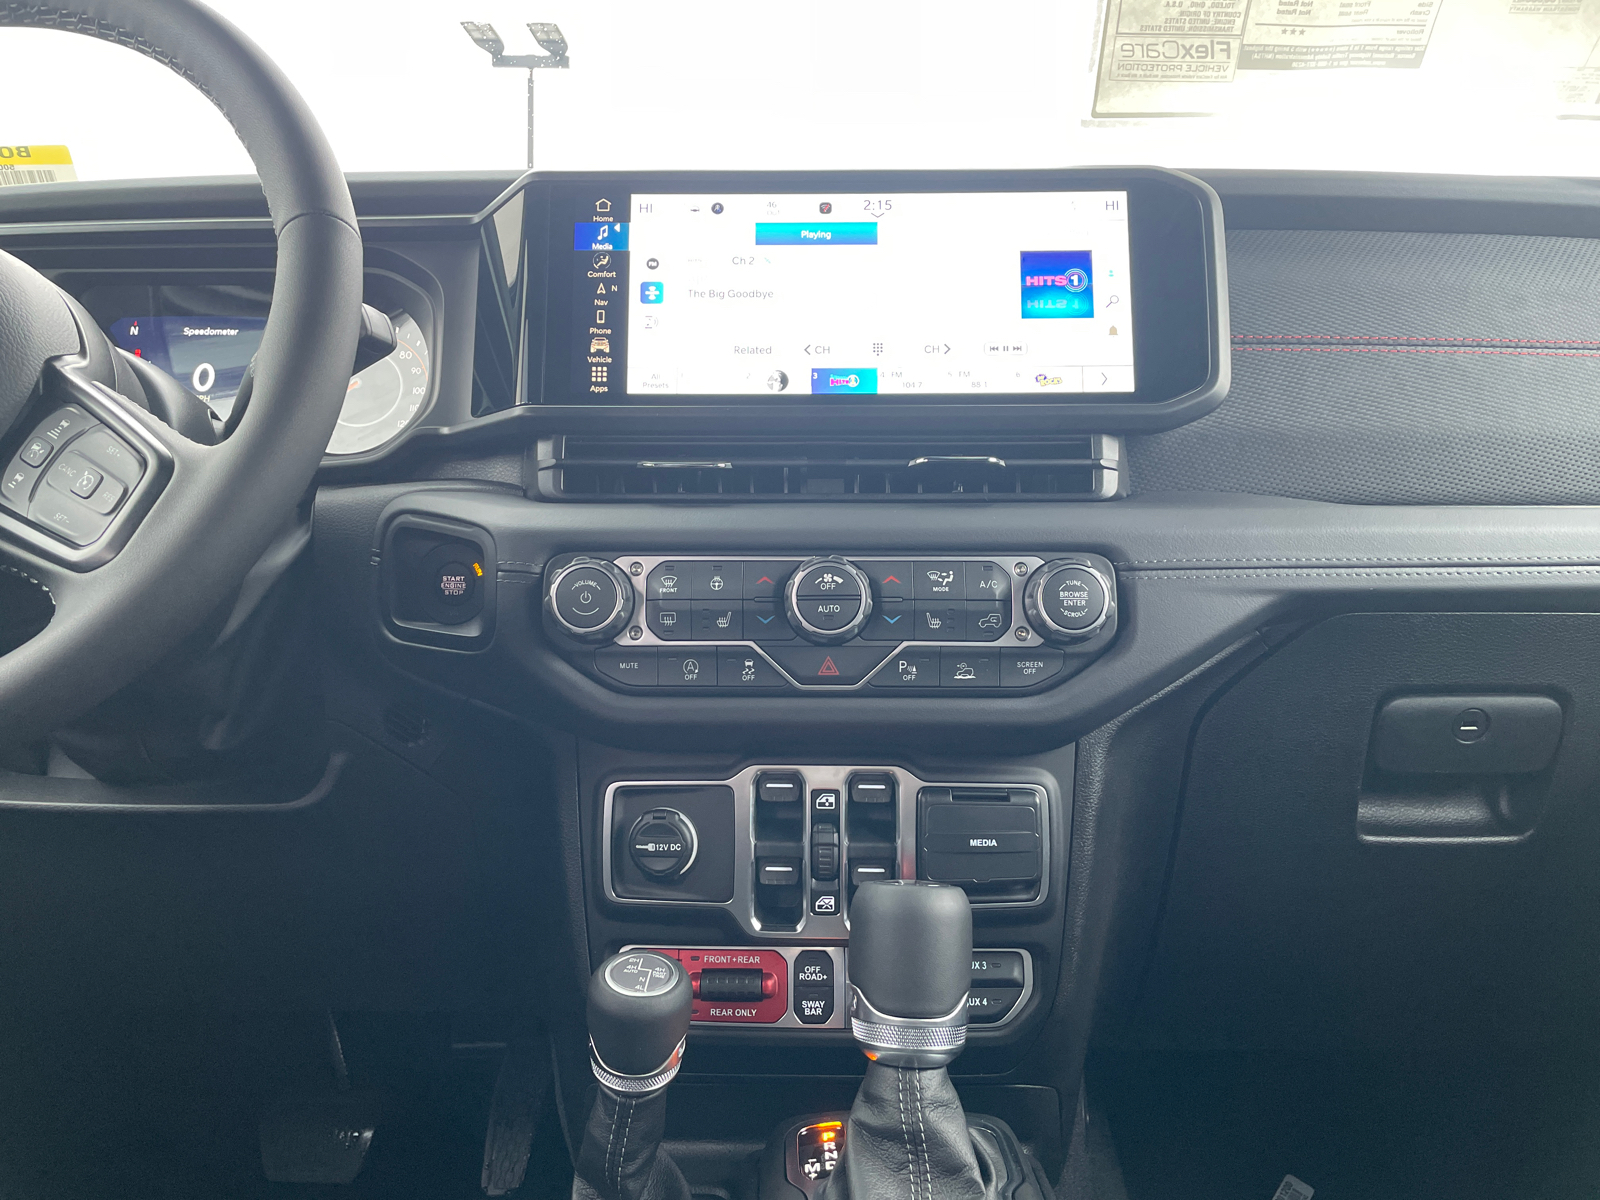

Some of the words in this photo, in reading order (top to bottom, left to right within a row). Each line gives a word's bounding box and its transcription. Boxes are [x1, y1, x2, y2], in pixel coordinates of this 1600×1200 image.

[639, 203, 653, 214] HI
[863, 200, 893, 211] 2:15
[1105, 201, 1119, 211] HI
[801, 230, 832, 240] Playing
[732, 256, 746, 266] Ch
[748, 257, 755, 265] 2
[1025, 275, 1067, 286] HITS
[688, 289, 706, 298] The
[708, 289, 726, 300] Big
[728, 289, 774, 300] Goodbye
[130, 326, 139, 336] N
[183, 327, 239, 336] Speedometer
[589, 327, 612, 335] Phone
[734, 345, 772, 355] Related
[814, 345, 831, 355] CH
[924, 345, 940, 354] CH
[399, 351, 412, 359] 80
[587, 356, 612, 364] Vehicle
[193, 362, 215, 392] 0
[589, 385, 608, 394] Apps
[642, 381, 669, 389] Presets
[412, 387, 426, 395] 100
[58, 463, 77, 477] CANC
[574, 579, 598, 588] VOLUME
[820, 583, 836, 591] OFF
[979, 580, 998, 589] A/C
[817, 604, 841, 613] AUTO
[1063, 609, 1087, 618] SCROLL
[619, 662, 639, 670] MUTE
[899, 661, 907, 673] P
[656, 843, 669, 851] 12V
[670, 843, 681, 851] DC
[969, 838, 998, 847] MEDIA
[982, 961, 987, 970] 3
[799, 973, 828, 981] ROAD+
[982, 997, 987, 1006] 4
[710, 1009, 733, 1017] REAR
[735, 1009, 757, 1017] ONLY
[804, 1008, 823, 1016] BAR
[822, 1131, 835, 1141] P
[823, 1142, 836, 1150] R
[824, 1150, 838, 1160] N
[804, 1162, 820, 1173] M
